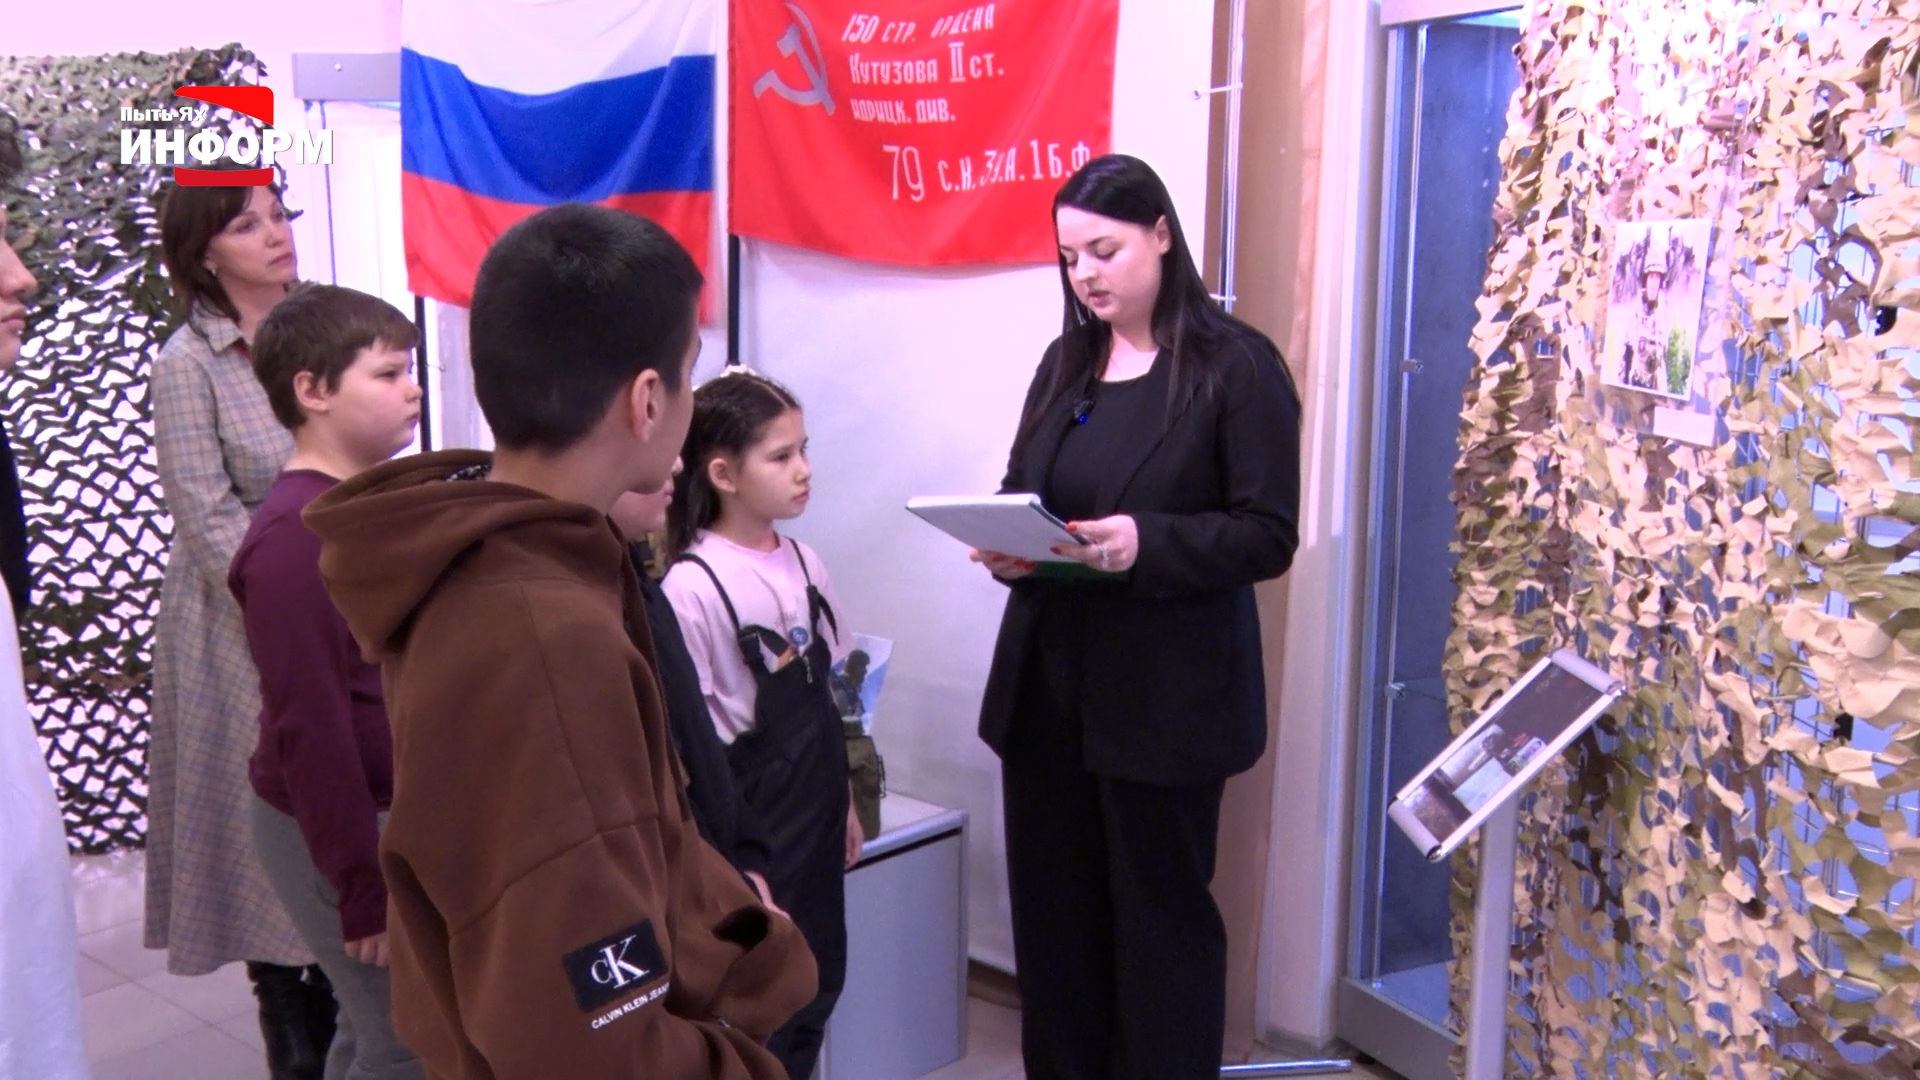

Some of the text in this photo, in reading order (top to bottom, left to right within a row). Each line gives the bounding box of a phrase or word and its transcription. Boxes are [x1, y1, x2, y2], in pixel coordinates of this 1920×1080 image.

[841, 14, 879, 43] 150
[930, 3, 995, 38] ОРДЕНА
[850, 97, 955, 126] ИДРИЦК. ДИВ.
[883, 144, 925, 202] 79
[591, 982, 671, 1029] CALVIN KLEIN JEAN
